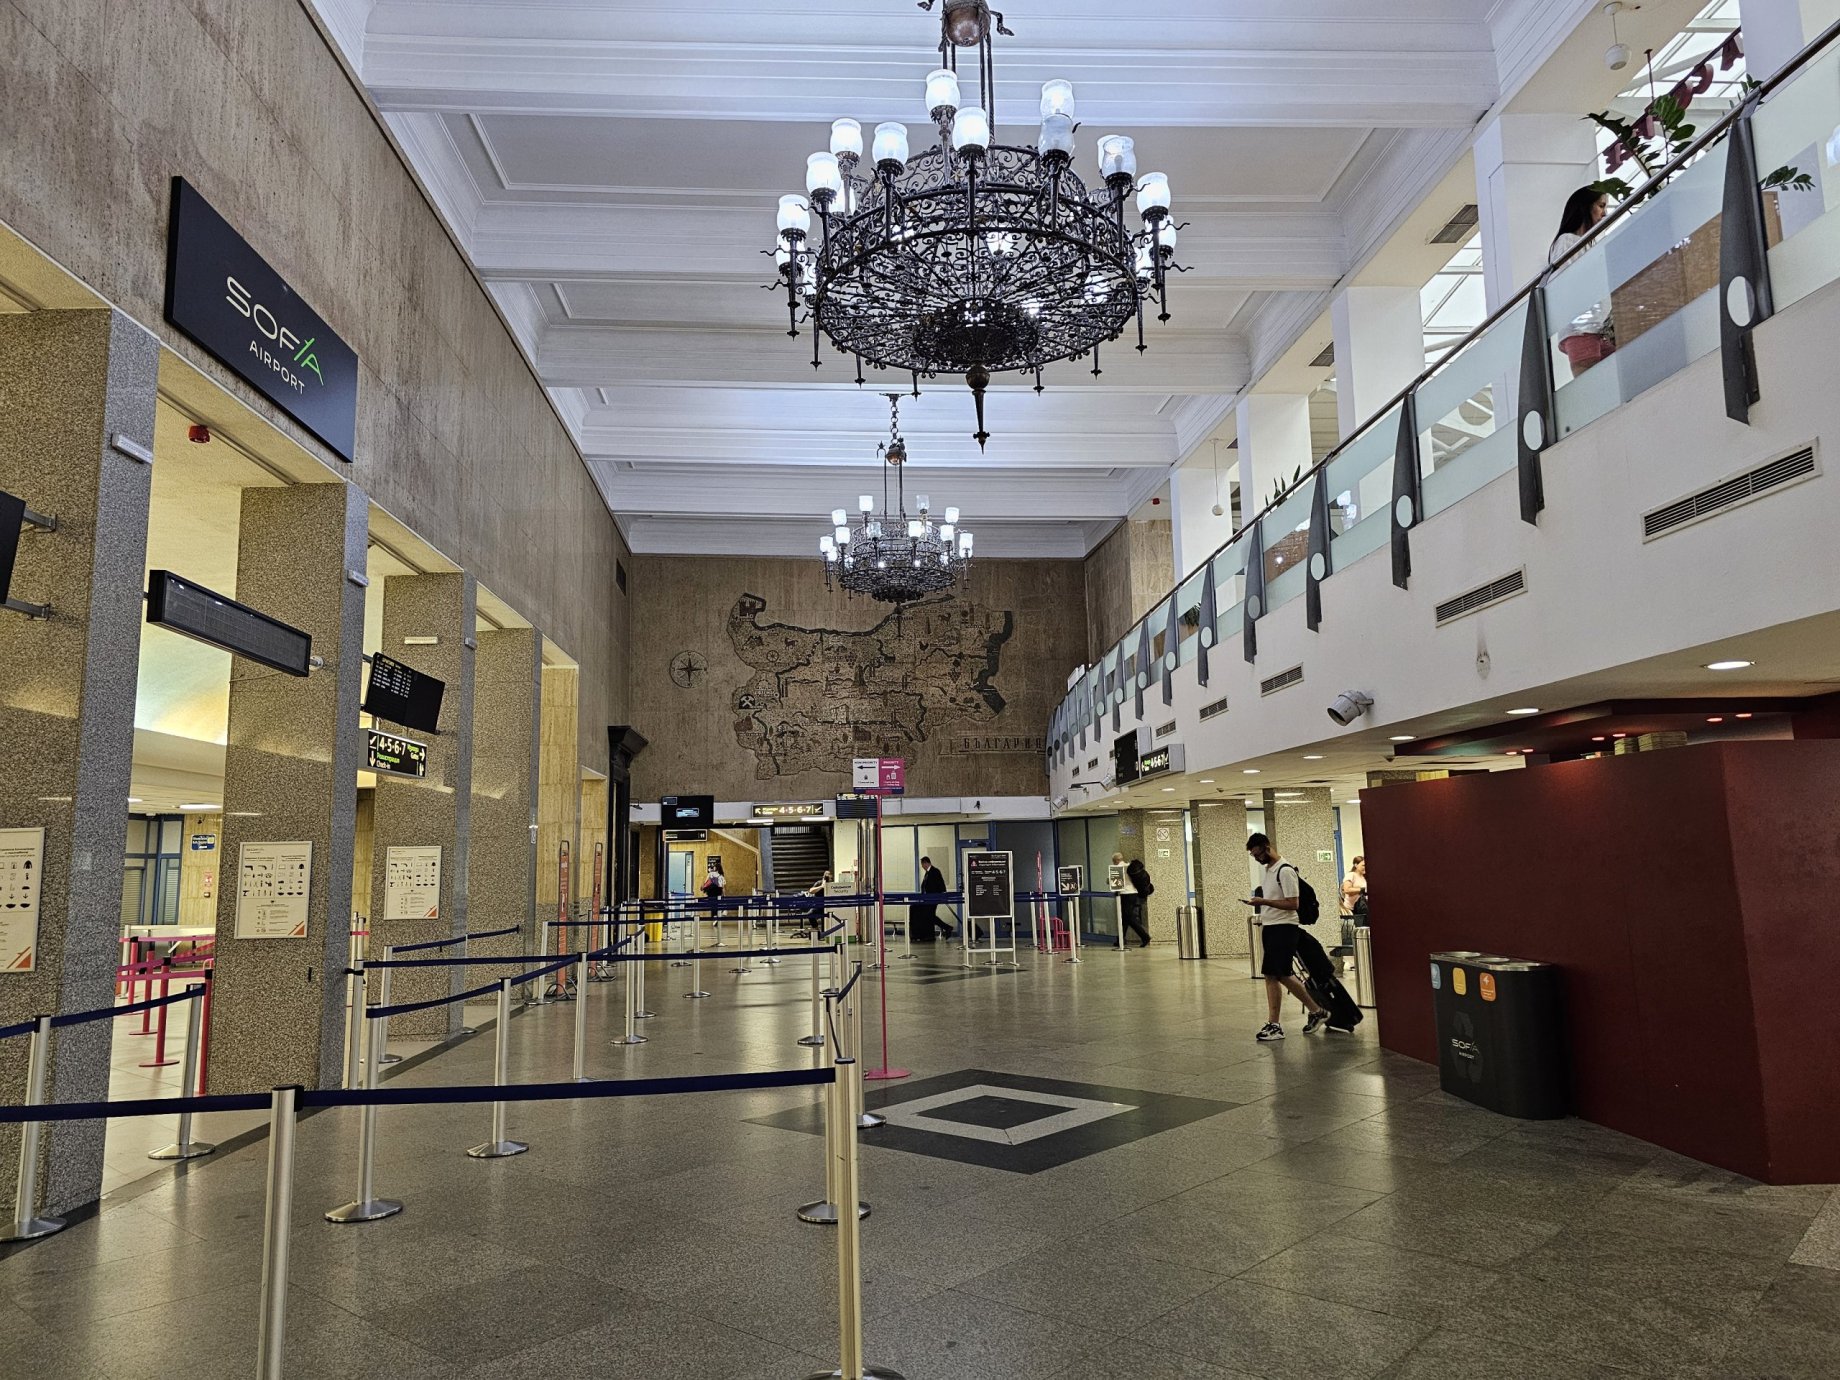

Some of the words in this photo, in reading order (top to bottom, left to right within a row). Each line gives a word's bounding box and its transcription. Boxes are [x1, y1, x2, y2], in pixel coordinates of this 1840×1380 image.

[226, 275, 324, 386] SOFIA
[249, 340, 305, 395] AIRPORT
[964, 737, 1043, 750] БЪЛГАРИЯ
[1451, 1038, 1480, 1054] SOFIA
